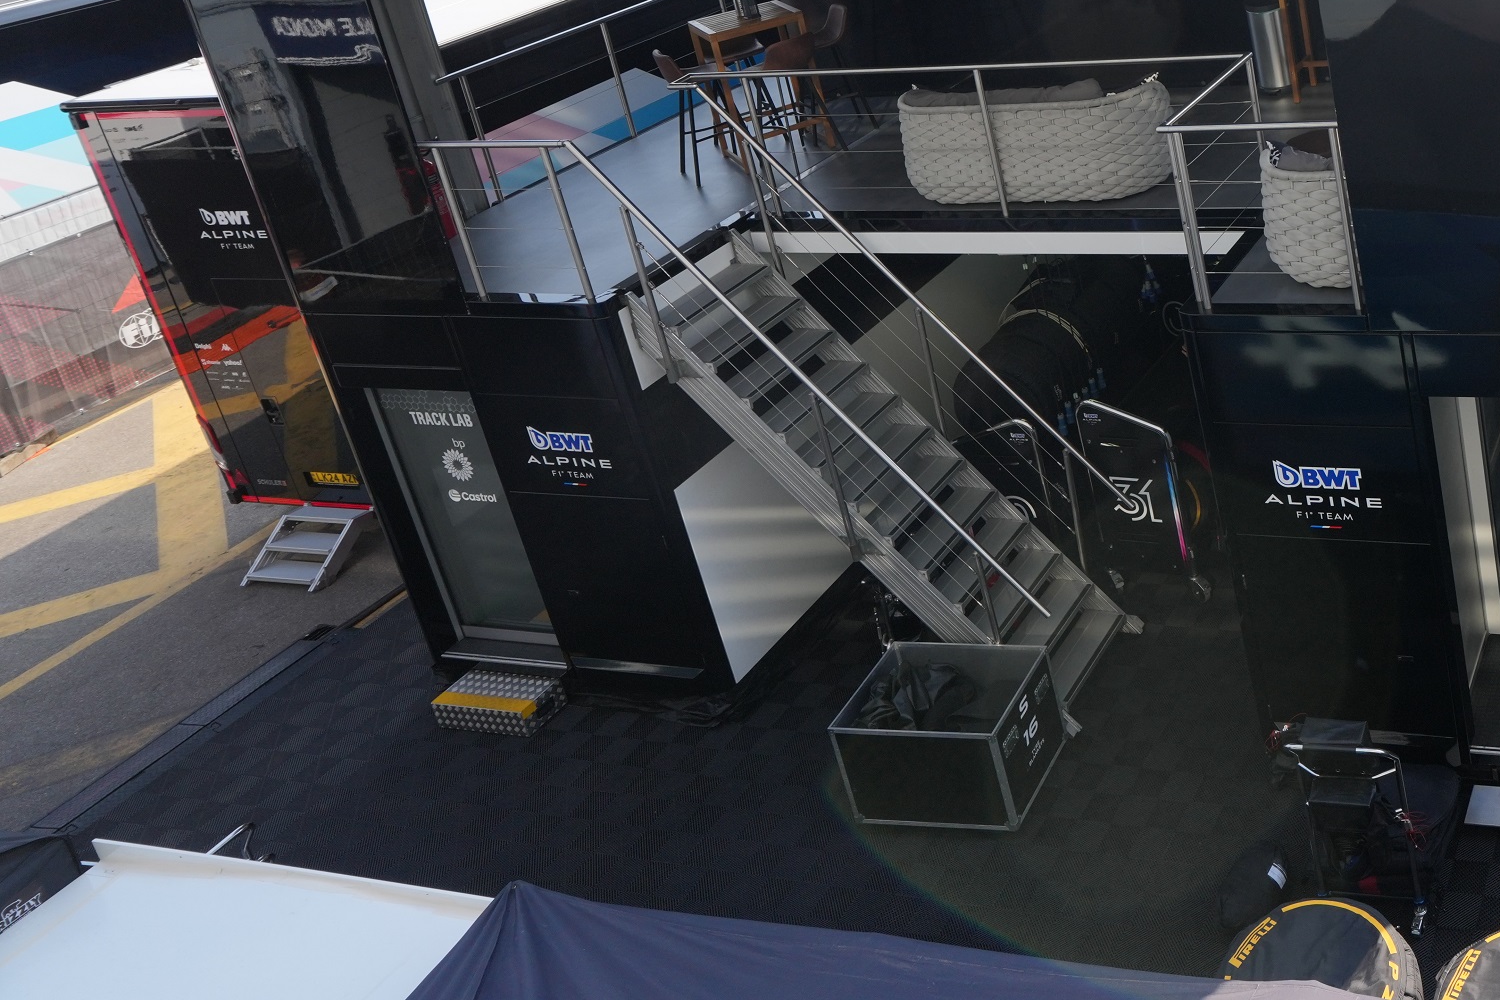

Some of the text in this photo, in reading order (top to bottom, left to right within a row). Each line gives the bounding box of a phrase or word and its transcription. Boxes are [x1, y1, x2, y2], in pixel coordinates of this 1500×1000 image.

[214, 211, 250, 225] BWT
[200, 230, 268, 239] ALPINE
[408, 411, 474, 428] TRACK LAB
[451, 438, 466, 450] bp
[546, 432, 594, 453] BWT
[527, 455, 613, 469] ALPINE
[567, 470, 594, 480] TEAM
[1299, 466, 1362, 491] BWT
[461, 491, 498, 503] Castrol
[1264, 493, 1383, 509] ALPINE
[1318, 511, 1354, 521] TEAM
[1023, 715, 1039, 747] 16
[1228, 917, 1277, 969] PIRELLI
